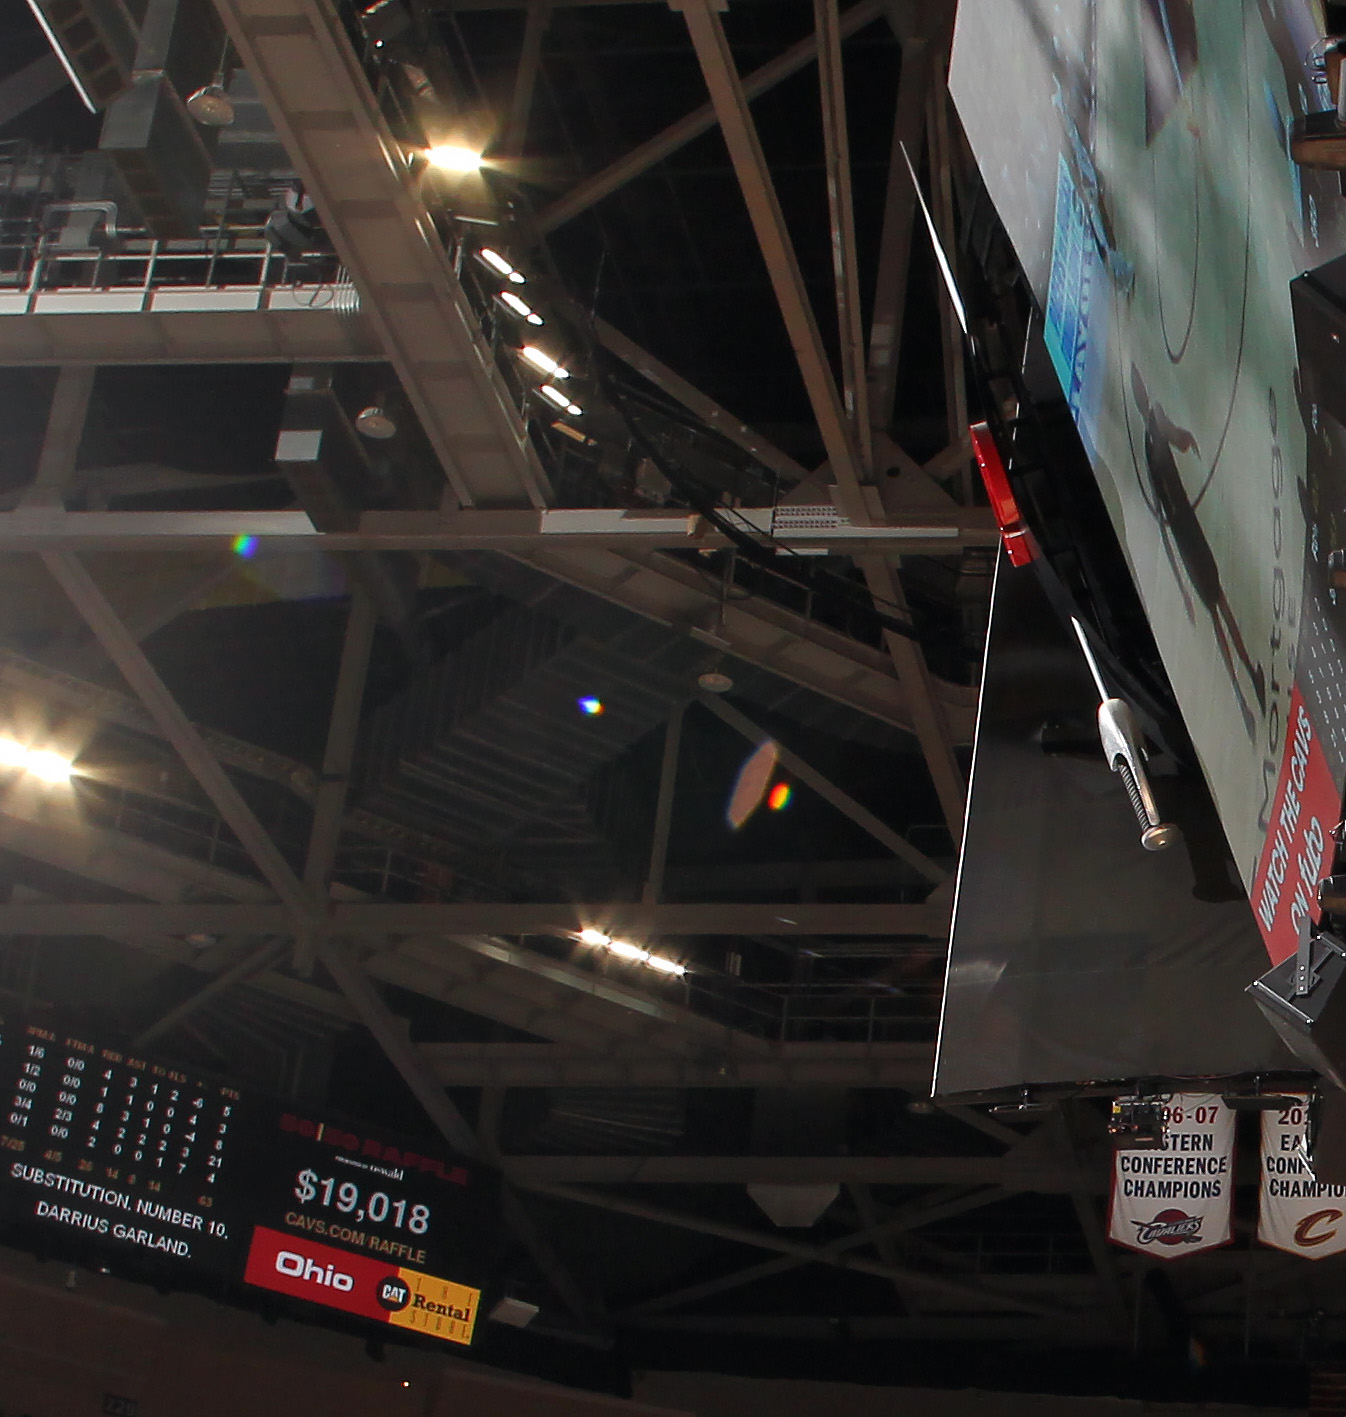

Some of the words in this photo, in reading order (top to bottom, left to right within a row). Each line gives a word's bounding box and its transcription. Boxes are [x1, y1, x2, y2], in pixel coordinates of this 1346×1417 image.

[1259, 830, 1290, 931] WATCH
[1291, 705, 1315, 791] CAVS
[1161, 1134, 1213, 1151] STERN
[1162, 1106, 1219, 1125] 06-07
[1121, 1156, 1227, 1175] CONFERENCE
[1124, 1180, 1221, 1199] CHAMPIONS
[10, 1162, 131, 1211] SUBSTITUTION.
[136, 1199, 203, 1230] NUMBER
[207, 1221, 228, 1239] 10.
[36, 1200, 108, 1233] DARRIUS
[113, 1224, 191, 1258] GARLAND.
[293, 1168, 430, 1235] $19,018
[275, 1250, 353, 1292] Ohio
[382, 1284, 406, 1302] CAT
[413, 1293, 471, 1321] Rental
